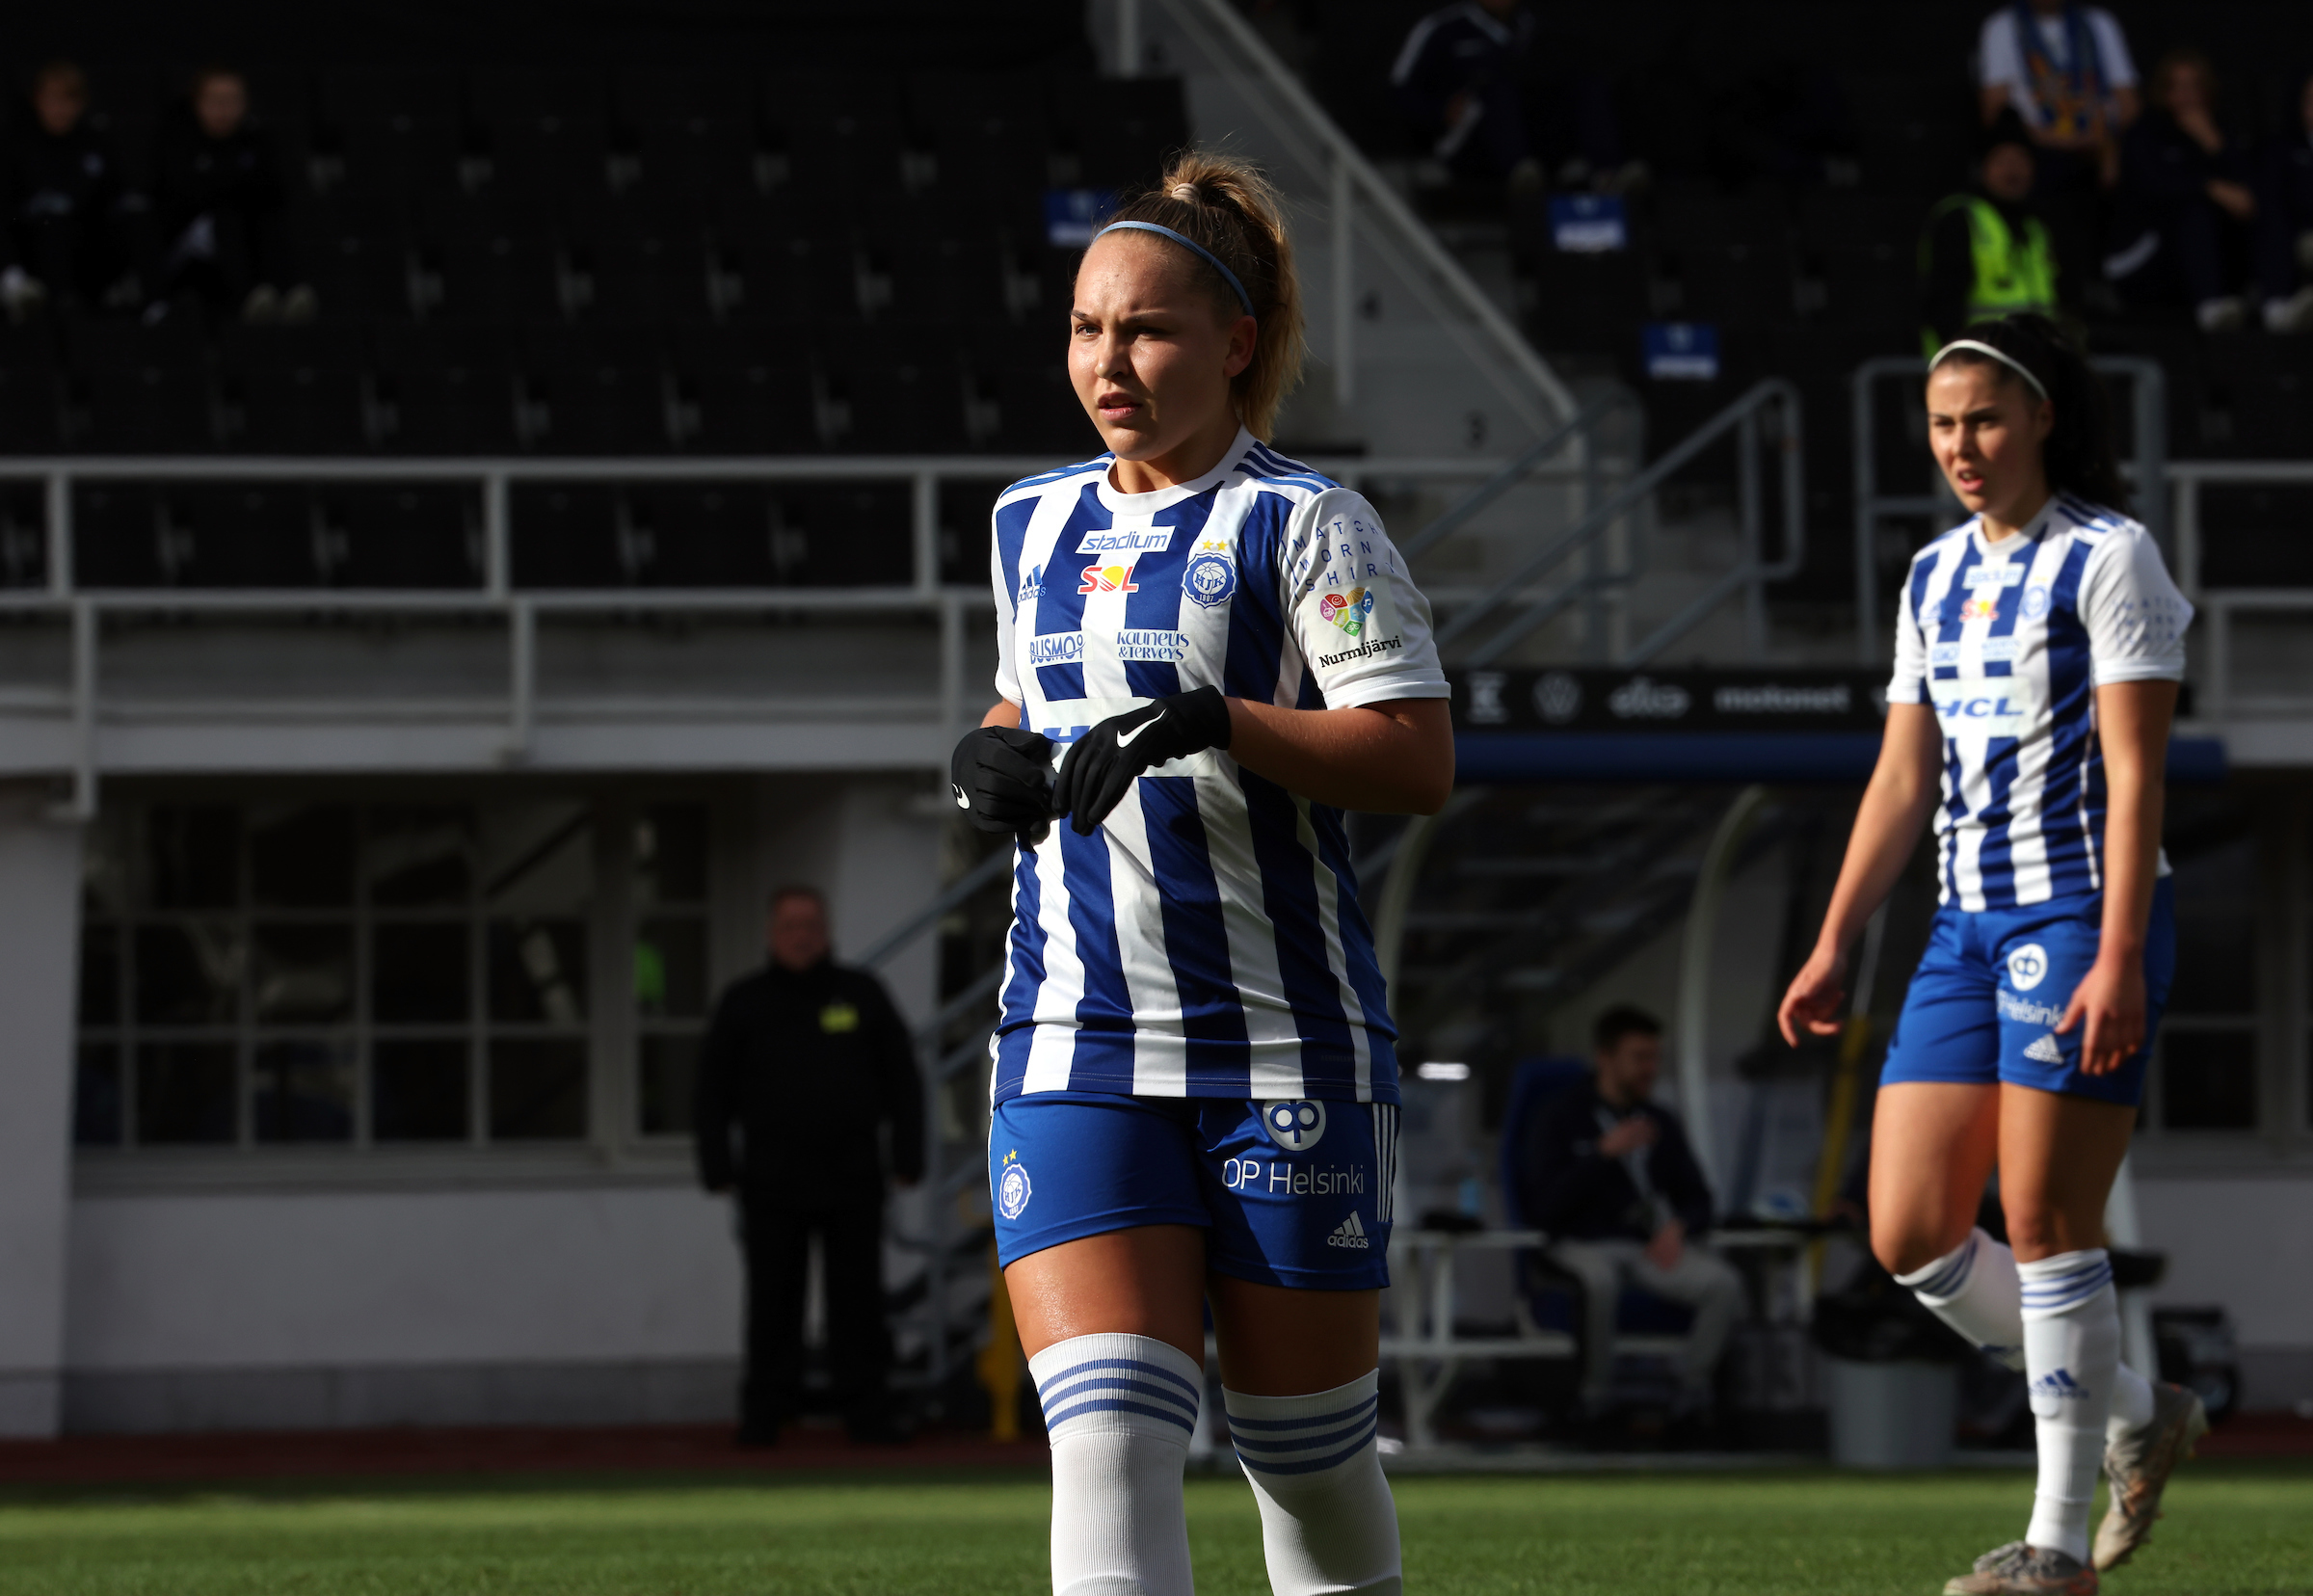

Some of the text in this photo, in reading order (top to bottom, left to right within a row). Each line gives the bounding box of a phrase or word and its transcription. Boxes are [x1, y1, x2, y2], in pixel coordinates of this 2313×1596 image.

[1082, 531, 1168, 550] stadium
[1079, 565, 1138, 593] SOL
[1195, 572, 1224, 591] HJK
[1018, 586, 1047, 603] adidas
[1199, 594, 1214, 602] 1907
[1318, 635, 1402, 668] Nurmijärvi
[1221, 1157, 1365, 1195] OP Helsinki
[1327, 1235, 1369, 1249] adidas
